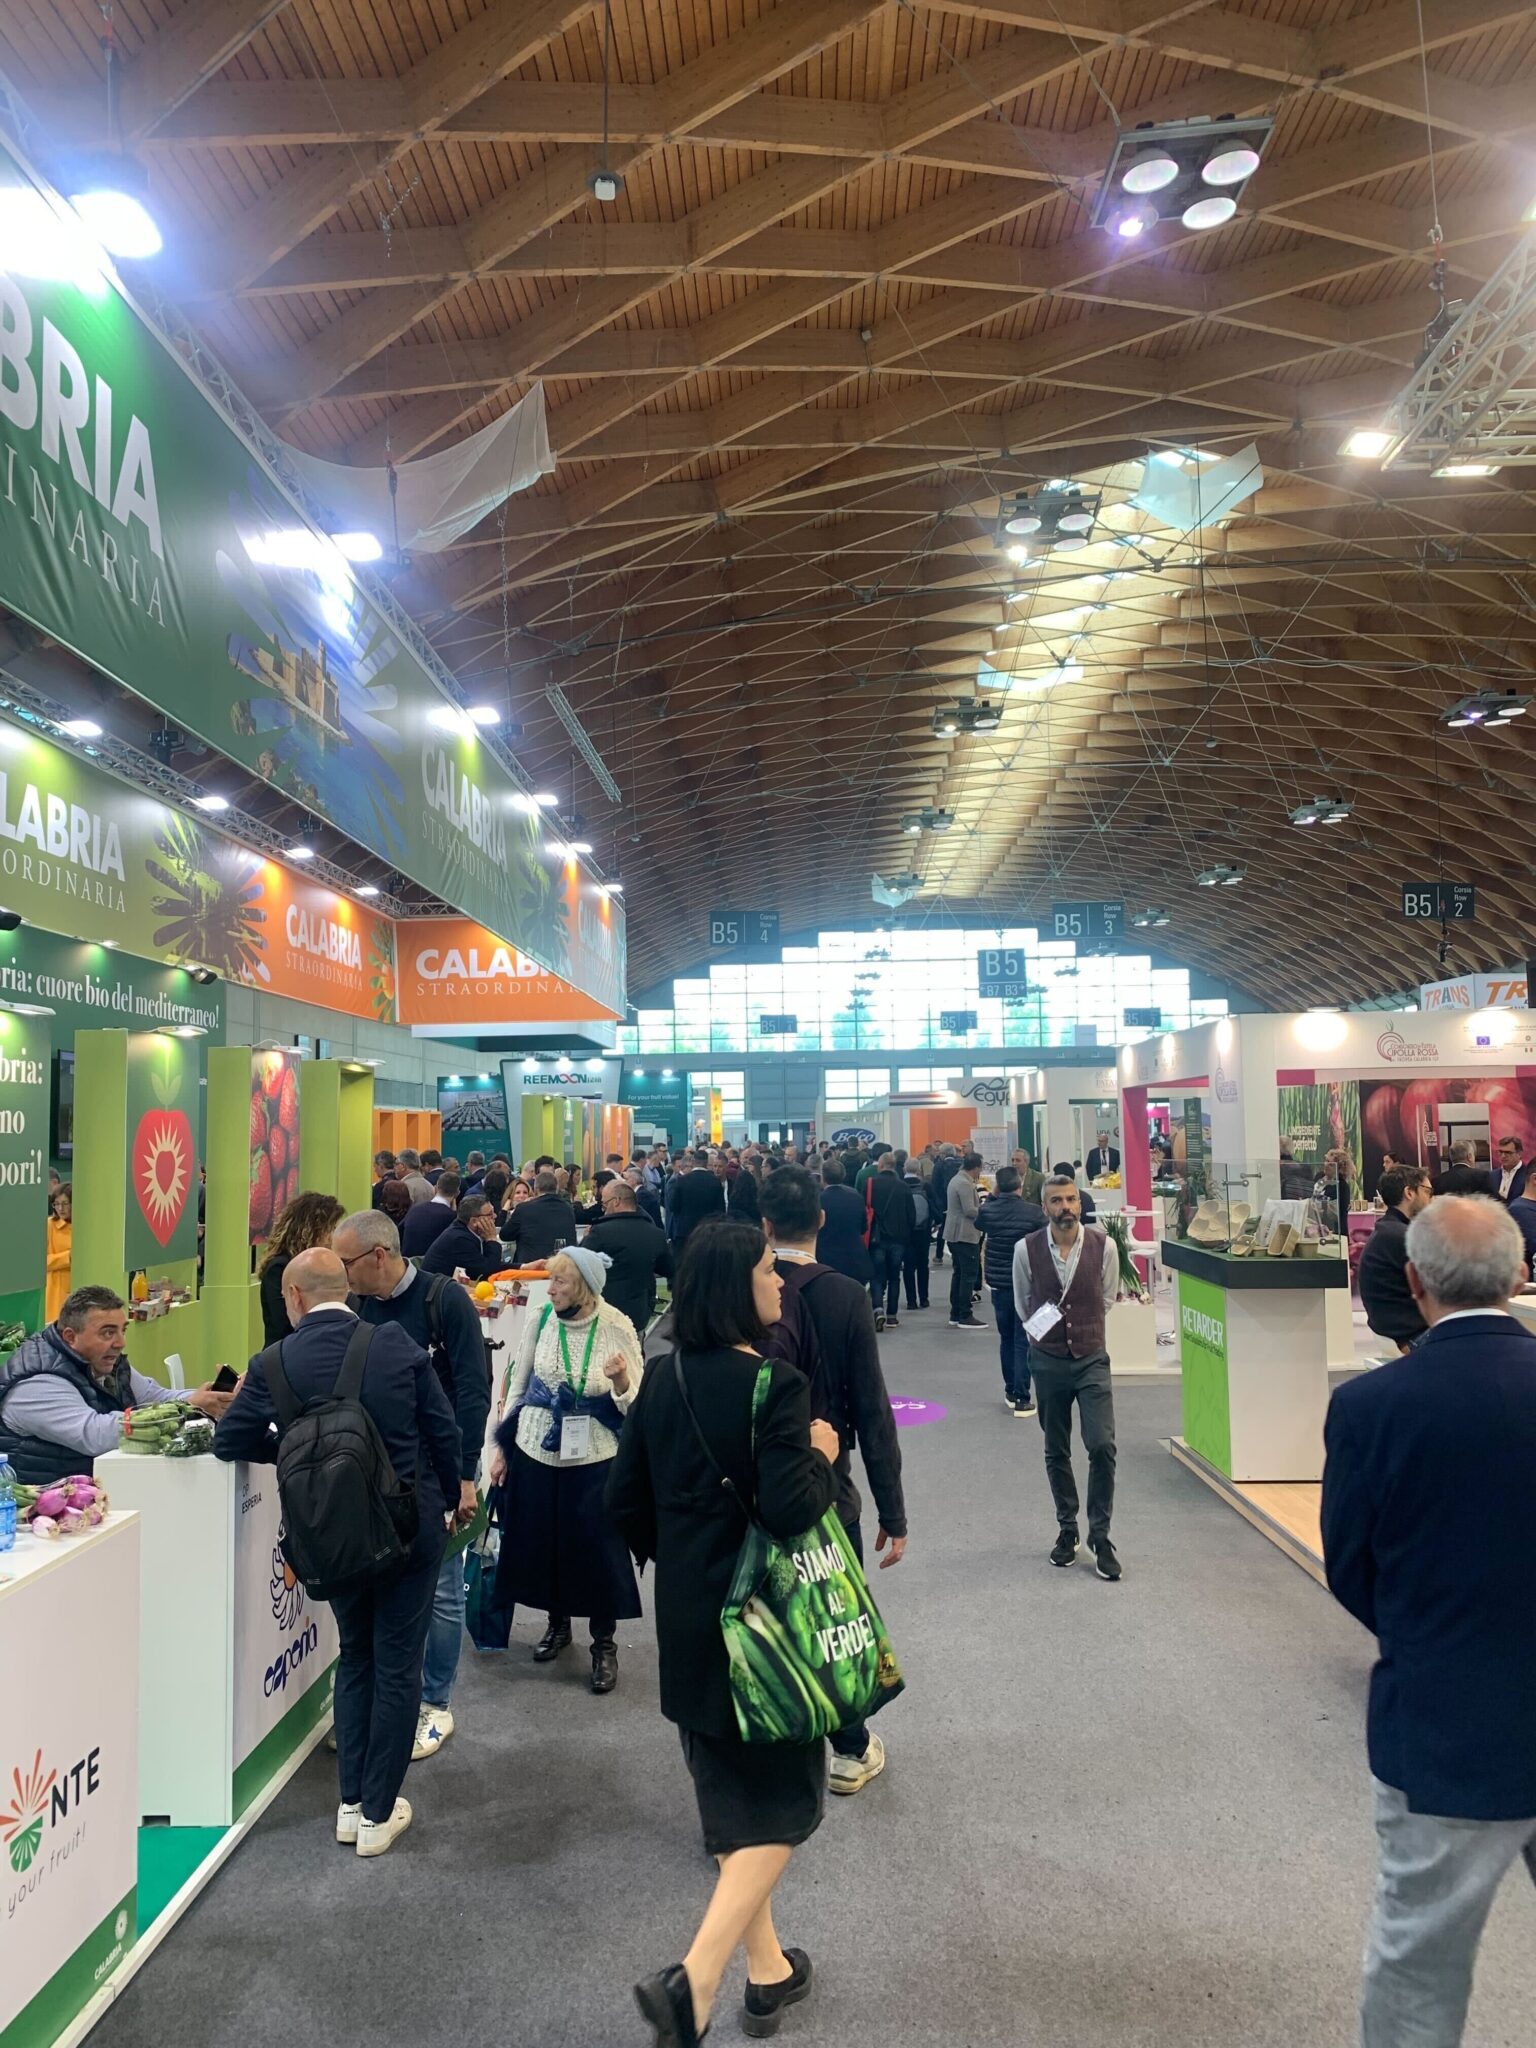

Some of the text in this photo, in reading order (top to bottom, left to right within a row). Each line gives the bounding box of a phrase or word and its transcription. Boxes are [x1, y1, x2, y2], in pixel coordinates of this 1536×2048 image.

[422, 738, 508, 873] CALABRIA
[1404, 893, 1432, 917] B5
[1455, 903, 1463, 917] 2
[712, 922, 738, 944] B5
[760, 929, 768, 943] 4
[1055, 914, 1082, 936] B5
[1104, 921, 1113, 935] 3
[286, 903, 363, 972] CALABRIA
[286, 951, 363, 991] STRAORDINARIA
[416, 948, 549, 978] CALAB
[985, 950, 1018, 976] B5
[0, 957, 219, 1029] ria: cuore bio del mediterraneo!
[416, 981, 580, 996] STRAORDINA
[987, 984, 1018, 996] B7 B3
[1424, 984, 1470, 1010] TRANS
[1487, 980, 1528, 1005] TR
[761, 1020, 776, 1033] B5
[941, 1016, 956, 1028] B5
[1417, 1048, 1438, 1056] ROSSA
[241, 1491, 262, 1514] ESPERIA
[792, 1542, 847, 1584] SIAMO
[828, 1592, 846, 1617] AL
[8, 1822, 86, 1920] your fruit!
